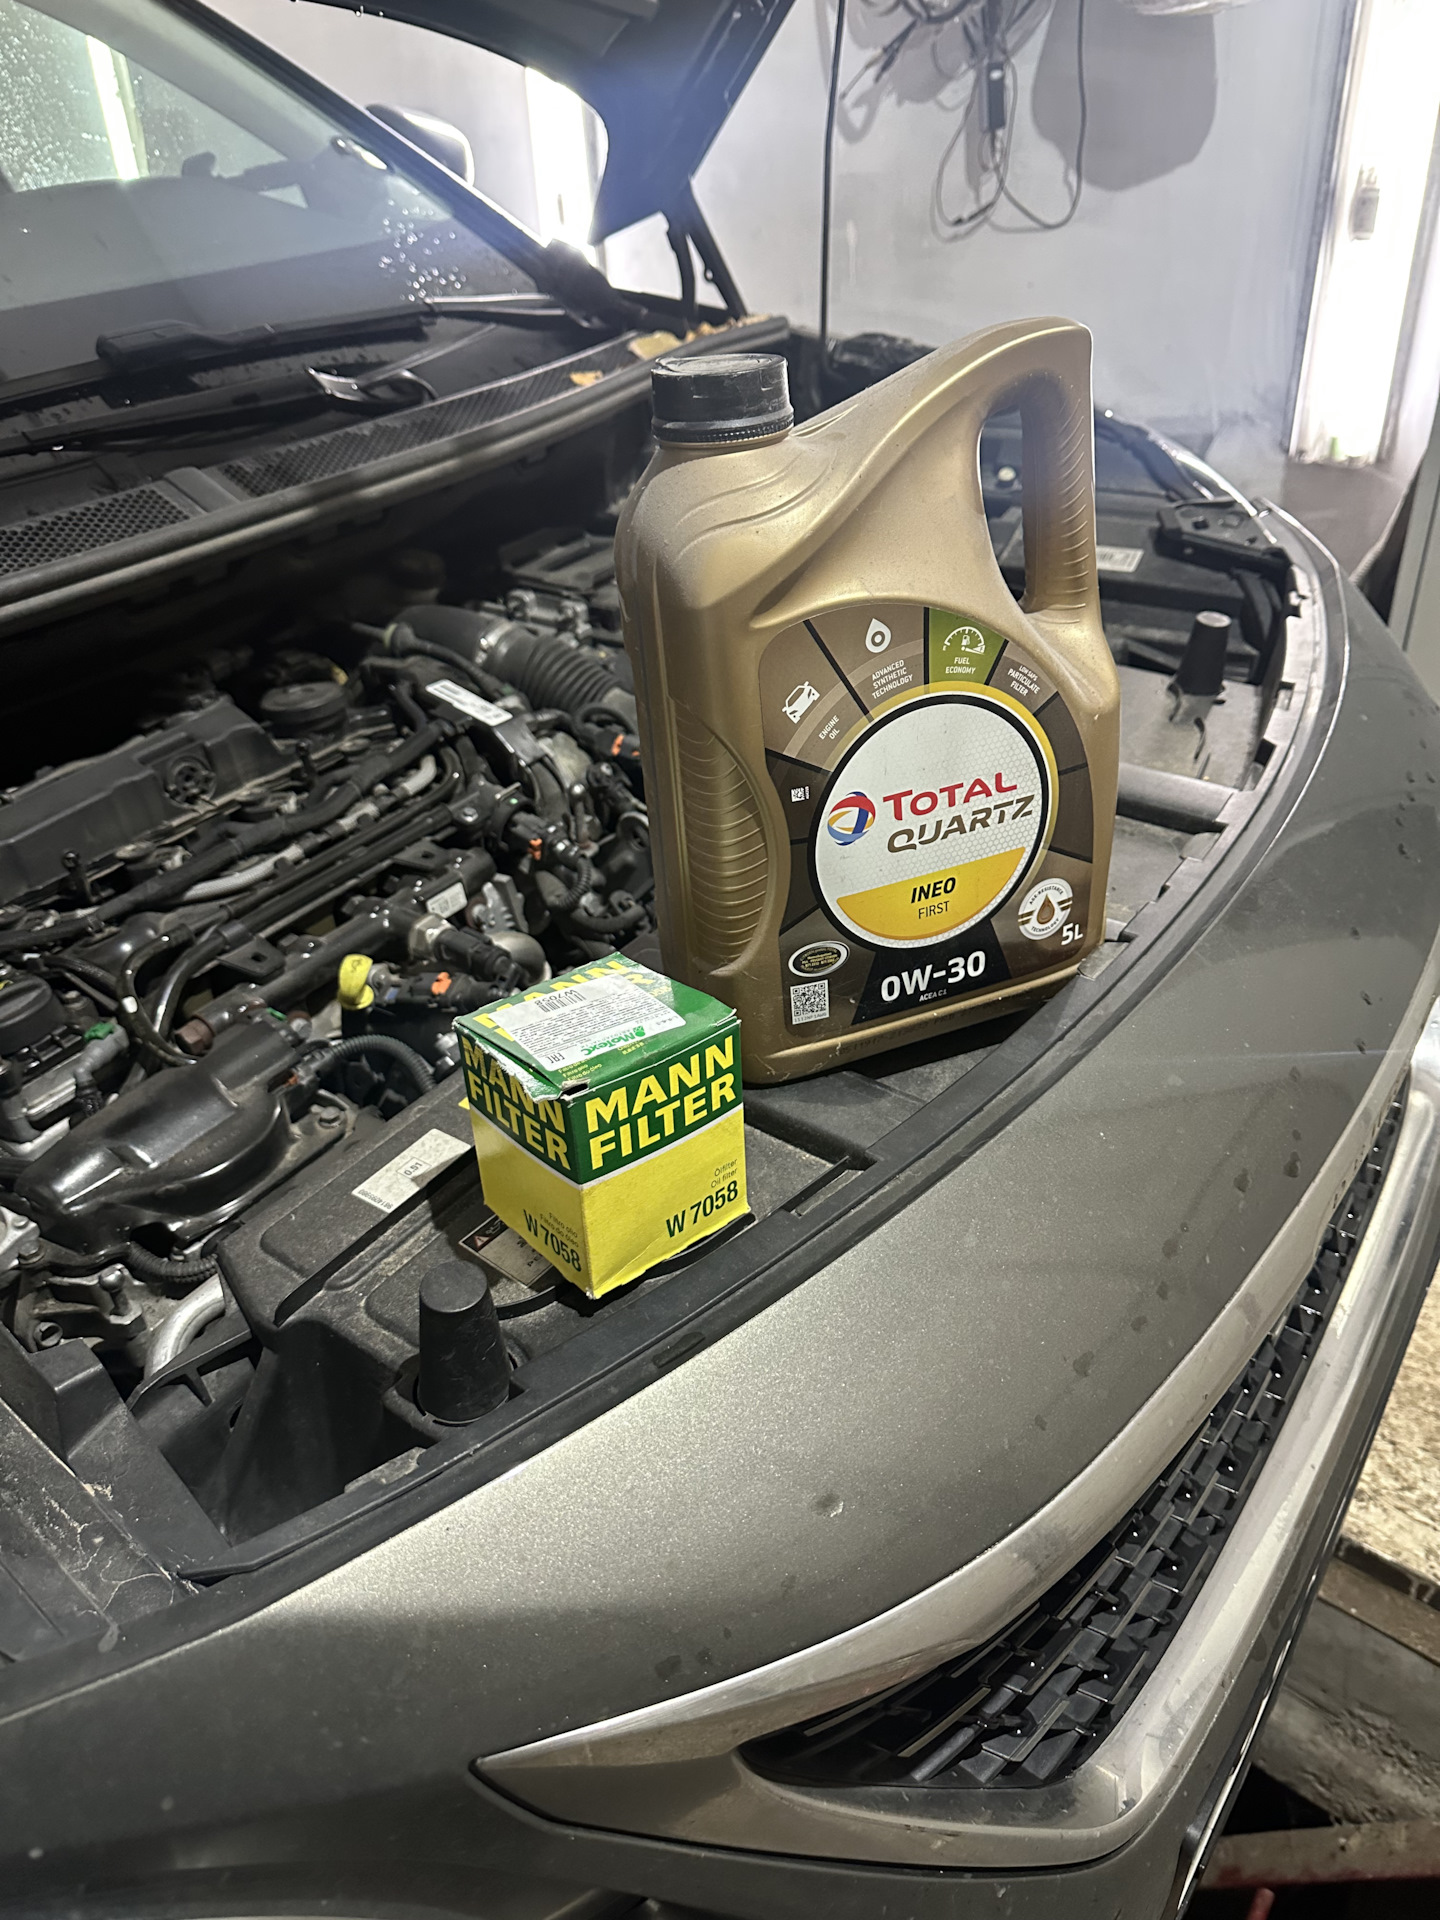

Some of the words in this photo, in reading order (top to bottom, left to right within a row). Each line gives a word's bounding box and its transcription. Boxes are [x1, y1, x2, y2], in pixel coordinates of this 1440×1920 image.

[871, 659, 905, 681] ADVANCED
[945, 665, 976, 675] ECONOMY
[954, 656, 970, 665] FUEL
[871, 674, 913, 699] TECHNOLOGY
[873, 668, 907, 690] SYNTHETIC
[1007, 668, 1041, 694] PARTICULATE
[1010, 680, 1029, 697] FILTER
[818, 714, 840, 740] ENGINE
[828, 727, 840, 740] OIL
[883, 772, 1018, 821] TOTAL
[887, 794, 1035, 853] QUARTZ
[910, 877, 957, 904] INEO
[918, 901, 950, 919] FIRST
[1061, 922, 1084, 946] 5L
[880, 950, 986, 1002] 0W-30
[535, 989, 577, 1006] W7058
[918, 990, 938, 1002] ACEA
[461, 1034, 566, 1134] MANN
[585, 1035, 734, 1134] MANN
[467, 1069, 572, 1171] FILTER
[589, 1072, 737, 1171] FILTER
[711, 1177, 721, 1188] Oil
[722, 1168, 738, 1182] filter
[665, 1212, 685, 1238] W
[690, 1180, 739, 1226] 7058
[523, 1208, 538, 1238] W
[540, 1223, 582, 1272] 7058
